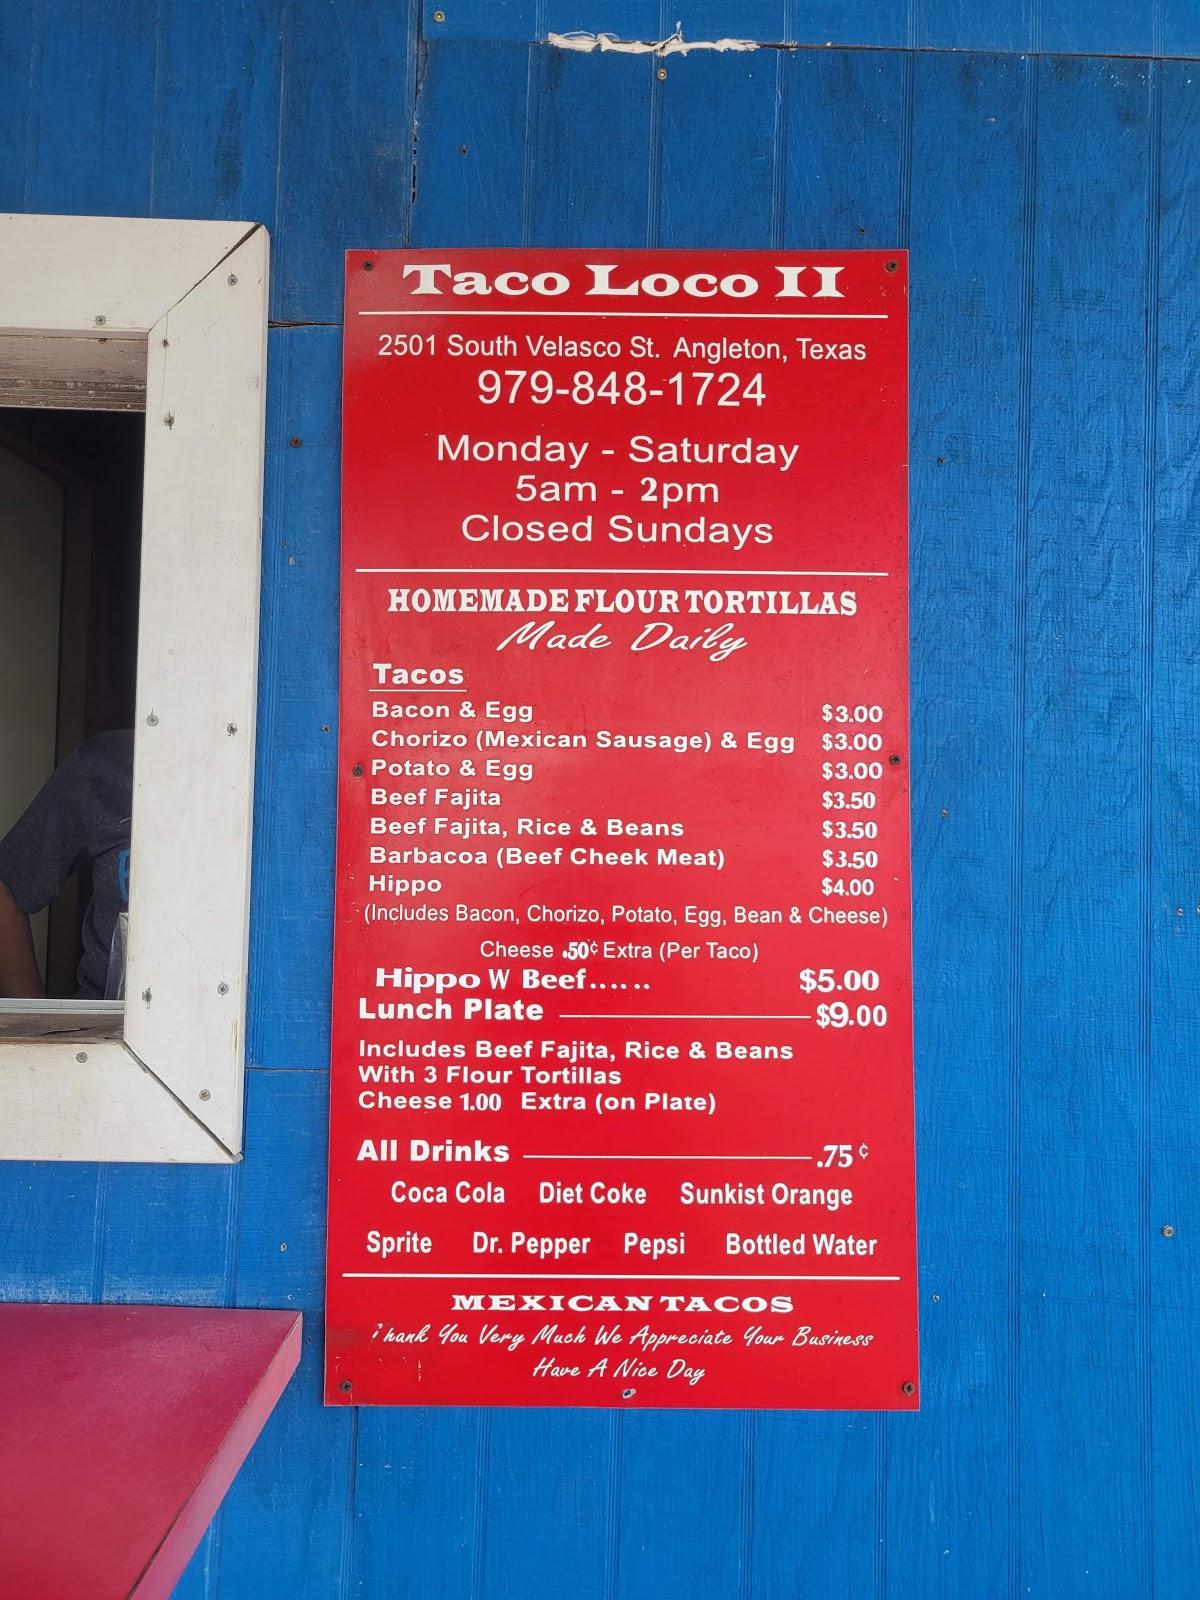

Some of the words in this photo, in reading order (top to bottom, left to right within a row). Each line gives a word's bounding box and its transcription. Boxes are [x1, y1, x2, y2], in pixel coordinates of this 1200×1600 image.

[403, 264, 569, 295] Taco
[585, 265, 758, 297] Loco
[775, 267, 845, 297] II
[379, 334, 434, 355] 2501
[448, 334, 516, 356] South
[526, 335, 621, 357] Velasco
[630, 336, 659, 357] St.
[673, 337, 787, 364] Angleton,
[796, 338, 866, 360] Texas
[479, 370, 766, 406] 979-848-1724
[438, 435, 588, 469] Monday
[629, 436, 799, 471] Saturday
[516, 475, 596, 501] 5am
[641, 477, 718, 509] 2pm
[462, 514, 592, 541] Closed
[609, 515, 772, 550] Sundays
[388, 589, 568, 612] HOMEMADE
[575, 589, 680, 613] FLOUR
[685, 590, 857, 616] TORTILLAS
[497, 621, 611, 650] Made
[631, 623, 747, 661] Daily
[373, 663, 463, 684] Tacos
[373, 702, 449, 717] Bacon
[459, 701, 476, 717] &
[486, 701, 532, 722] Egg
[823, 704, 882, 722] $3.00
[372, 730, 467, 747] Chorizo
[477, 731, 586, 751] (Mexican
[596, 731, 711, 752] Sausage)
[721, 732, 737, 748] &
[748, 732, 794, 753] Egg
[822, 733, 882, 751] $3.00
[372, 759, 450, 776] Potato
[460, 760, 476, 776] &
[486, 760, 532, 781] Egg
[822, 762, 882, 780] $3.00
[372, 789, 427, 805] Beef
[435, 789, 500, 809] Fajita
[822, 791, 876, 809] $3.50
[371, 818, 426, 834] Beef
[435, 818, 507, 839] Fajita,
[518, 818, 570, 835] Rice
[581, 819, 597, 835] &
[608, 819, 683, 836] Beans
[822, 820, 877, 839] $3.50
[371, 847, 487, 864] Barbacoa
[497, 848, 562, 868] (Beef
[571, 848, 648, 865] Cheek
[658, 849, 724, 870] Meat)
[823, 849, 878, 869] $3.50
[370, 875, 441, 896] Hippo
[822, 877, 874, 896] $4.00
[365, 904, 448, 924] (Includes
[456, 904, 519, 924] Bacon,
[528, 905, 604, 925] Chorizo,
[613, 905, 677, 925] Potato,
[686, 906, 726, 927] Egg,
[735, 906, 782, 923] Bean
[789, 907, 801, 923] &
[809, 906, 887, 928] Cheese)
[481, 941, 553, 958] Cheese
[604, 942, 652, 958] Extra
[660, 942, 700, 962] (Per
[706, 942, 758, 962] Taco)
[376, 967, 480, 993] Hippo
[489, 969, 510, 989] W
[800, 969, 879, 993] $5.00
[360, 998, 451, 1019] Lunch
[465, 998, 543, 1020] Plate
[816, 1002, 887, 1028] $9.00
[360, 1040, 465, 1057] Includes
[476, 1041, 533, 1058] Beef
[541, 1041, 615, 1063] Fajita,
[626, 1041, 679, 1059] Rice
[689, 1042, 706, 1059] &
[716, 1042, 793, 1059] Beans
[359, 1066, 414, 1083] With
[424, 1066, 437, 1083] 3
[447, 1066, 512, 1083] Flour
[521, 1066, 621, 1084] Tortillas
[359, 1091, 452, 1109] Cheese
[460, 1093, 501, 1111] 1.00
[522, 1092, 586, 1109] Extra
[596, 1093, 635, 1114] (on
[645, 1093, 715, 1114] Plate)
[357, 1140, 397, 1161] All
[411, 1140, 509, 1162] Drinks
[392, 1181, 447, 1203] Coca
[456, 1181, 504, 1203] Cola
[540, 1182, 583, 1203] Diet
[591, 1182, 646, 1204] Coke
[681, 1182, 764, 1204] Sunkist
[772, 1183, 852, 1211] Orange
[367, 1231, 432, 1258] Sprite
[473, 1232, 502, 1253] Dr.
[512, 1232, 591, 1259] Pepper
[625, 1232, 684, 1259] Pepsi
[727, 1233, 805, 1255] Bottled
[813, 1234, 877, 1255] Water
[452, 1295, 653, 1311] MEXICAN
[660, 1296, 793, 1313] TACOS
[439, 1324, 467, 1344] You
[480, 1324, 525, 1351] Very
[531, 1325, 585, 1344] Much
[595, 1325, 622, 1345] We
[629, 1325, 732, 1351] Appreciate
[744, 1326, 784, 1346] Your
[792, 1326, 873, 1346] Business
[533, 1357, 580, 1376] Have
[588, 1358, 608, 1377] A
[613, 1358, 658, 1377] Nice
[667, 1359, 705, 1385] Day
